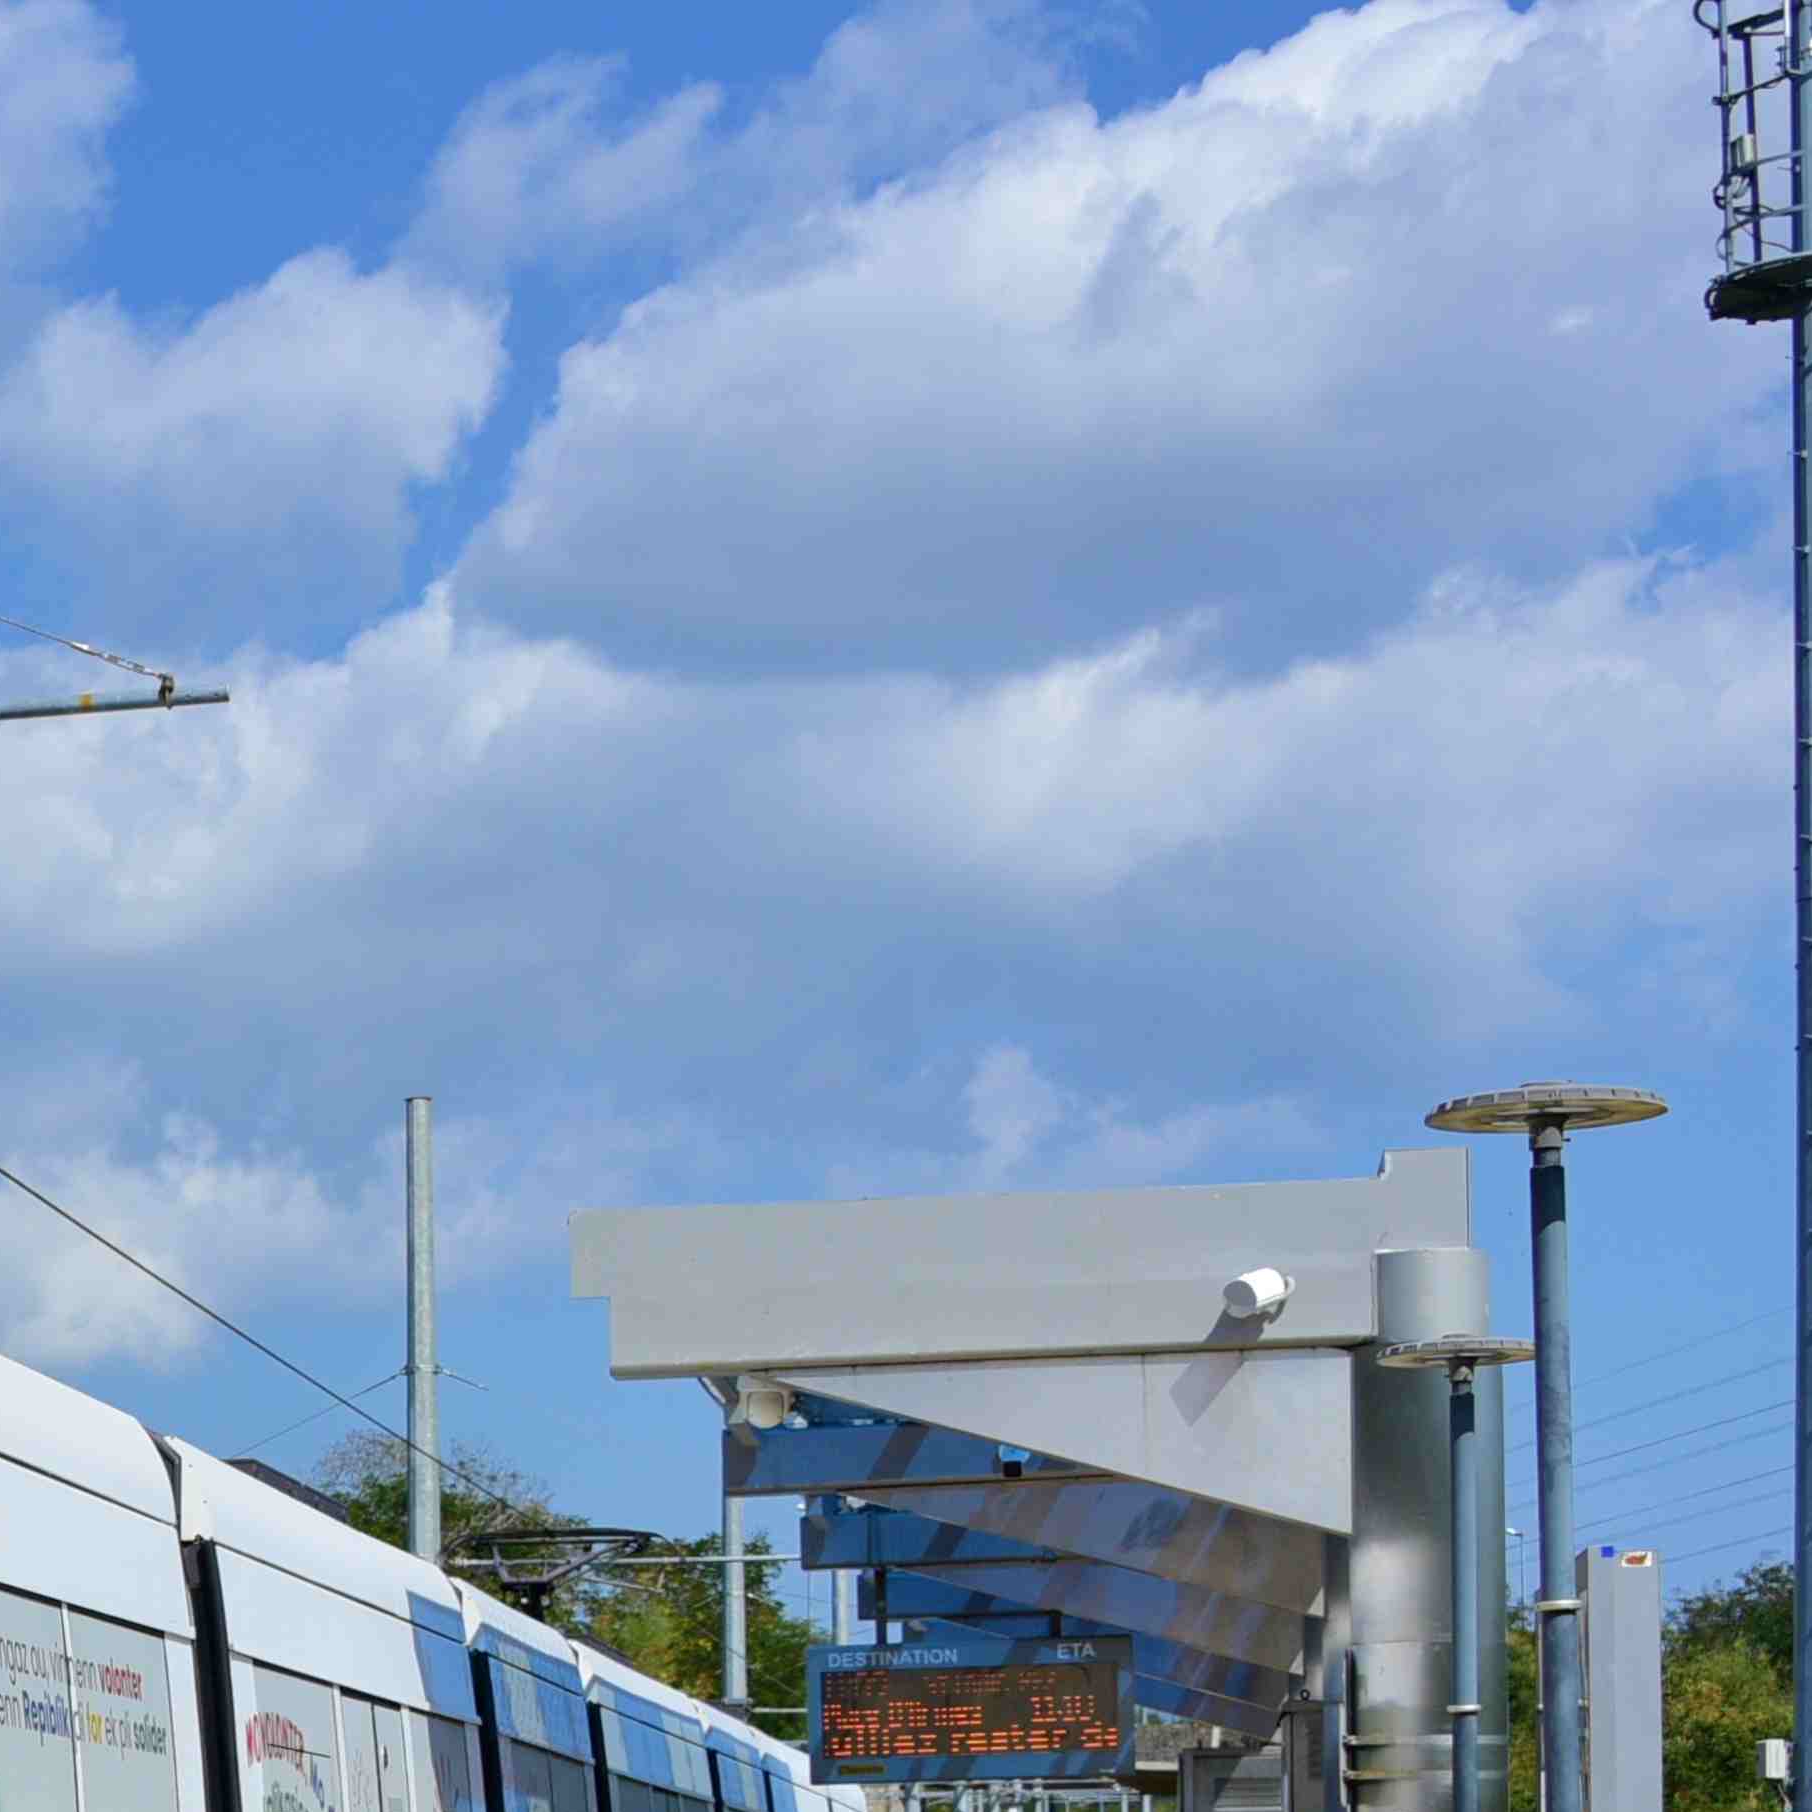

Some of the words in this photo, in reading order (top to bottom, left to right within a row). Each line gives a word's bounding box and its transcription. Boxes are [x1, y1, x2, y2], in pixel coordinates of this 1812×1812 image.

[827, 1647, 959, 1668] DESTINATION
[1056, 1642, 1096, 1659] ETA
[98, 1659, 143, 1700] volonter
[23, 1689, 71, 1746] Repiblik
